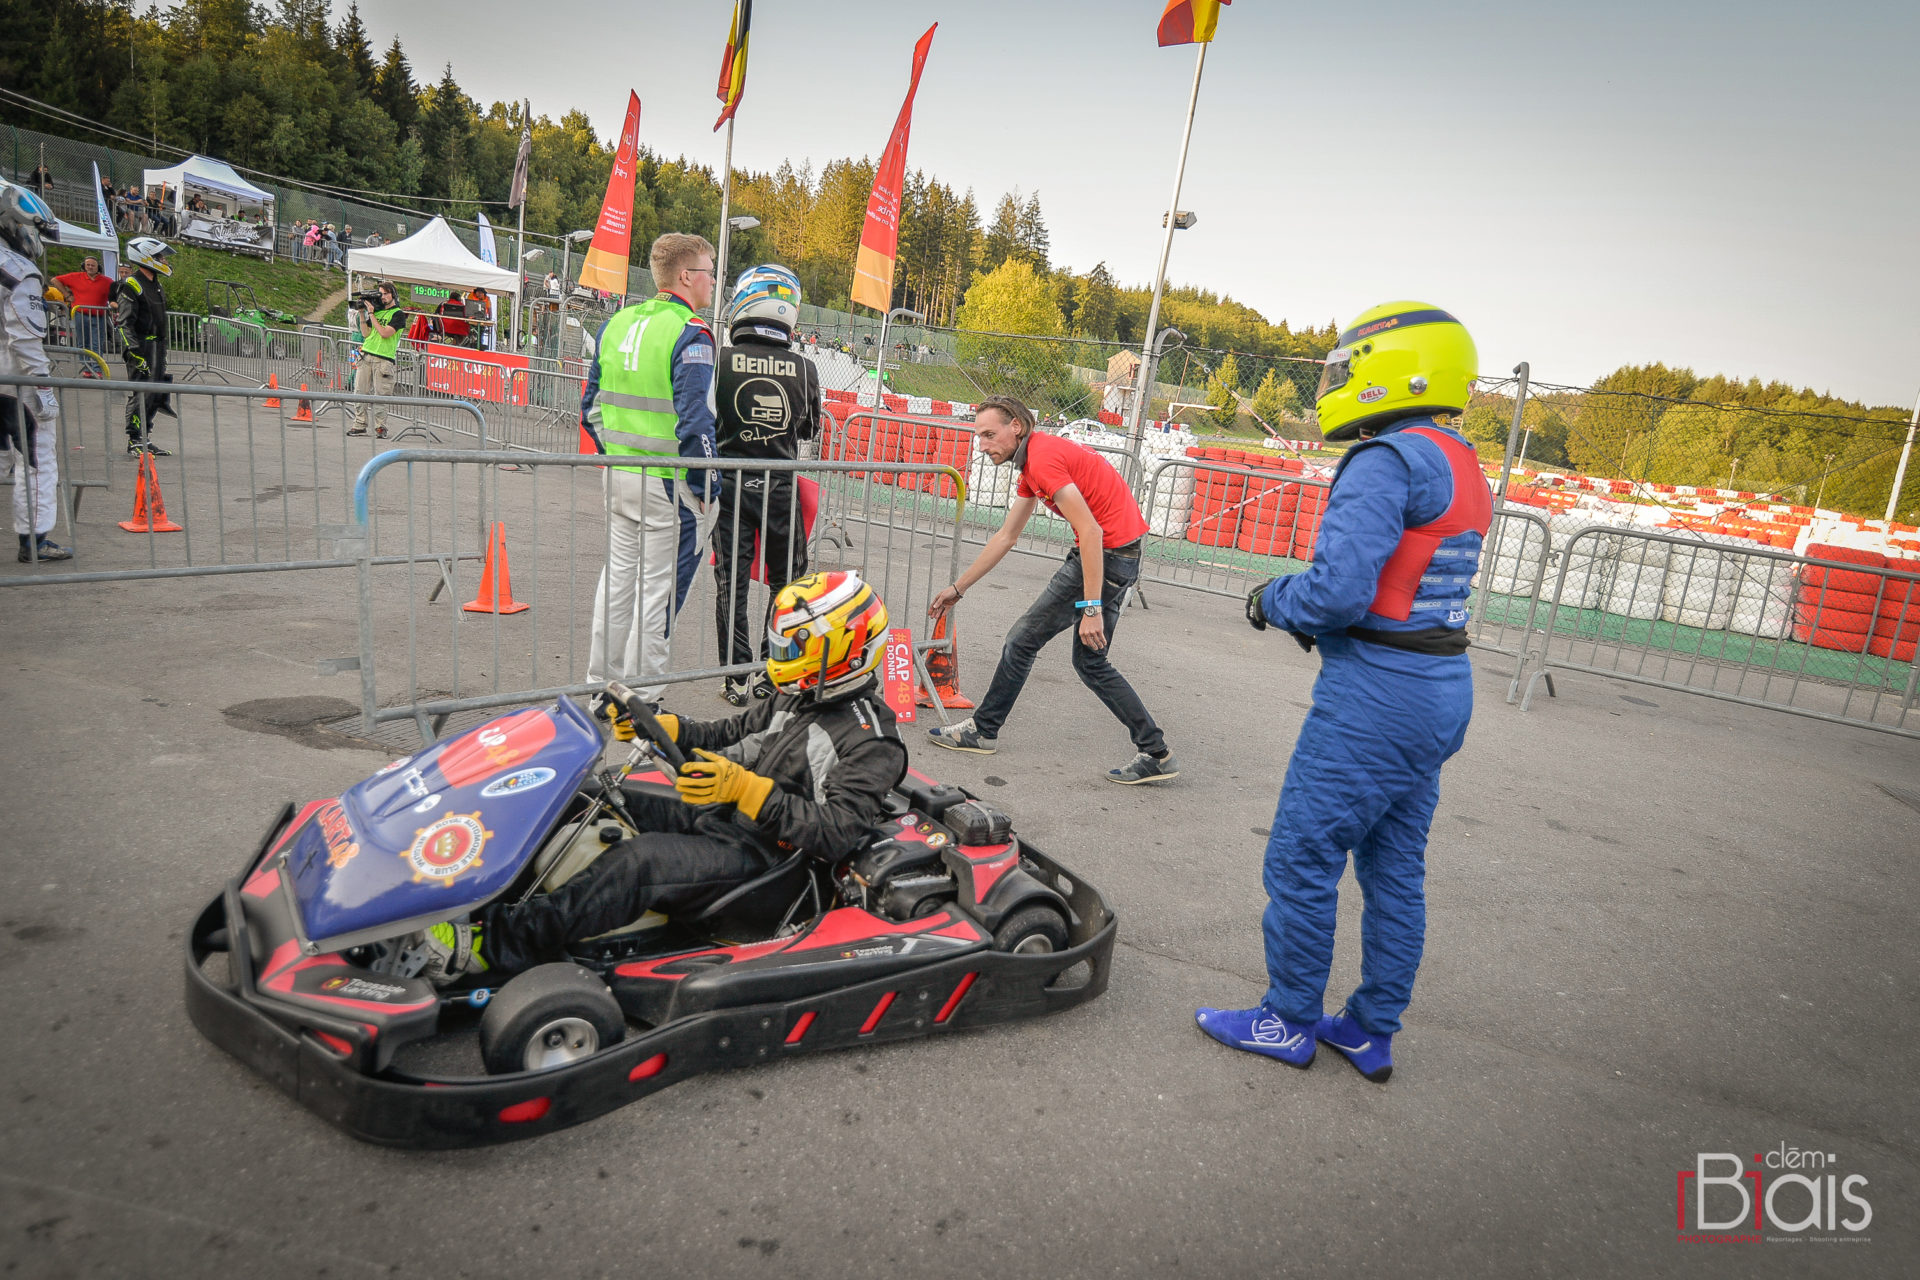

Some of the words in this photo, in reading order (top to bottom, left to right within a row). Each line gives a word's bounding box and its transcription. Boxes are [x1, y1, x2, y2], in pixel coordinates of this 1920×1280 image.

[414, 286, 450, 299] 19:00:11
[618, 315, 651, 372] 41
[1360, 389, 1384, 401] BELL
[887, 645, 896, 681] DONNE
[894, 632, 911, 704] #CAP48
[461, 819, 481, 866] AUTOMOBILE
